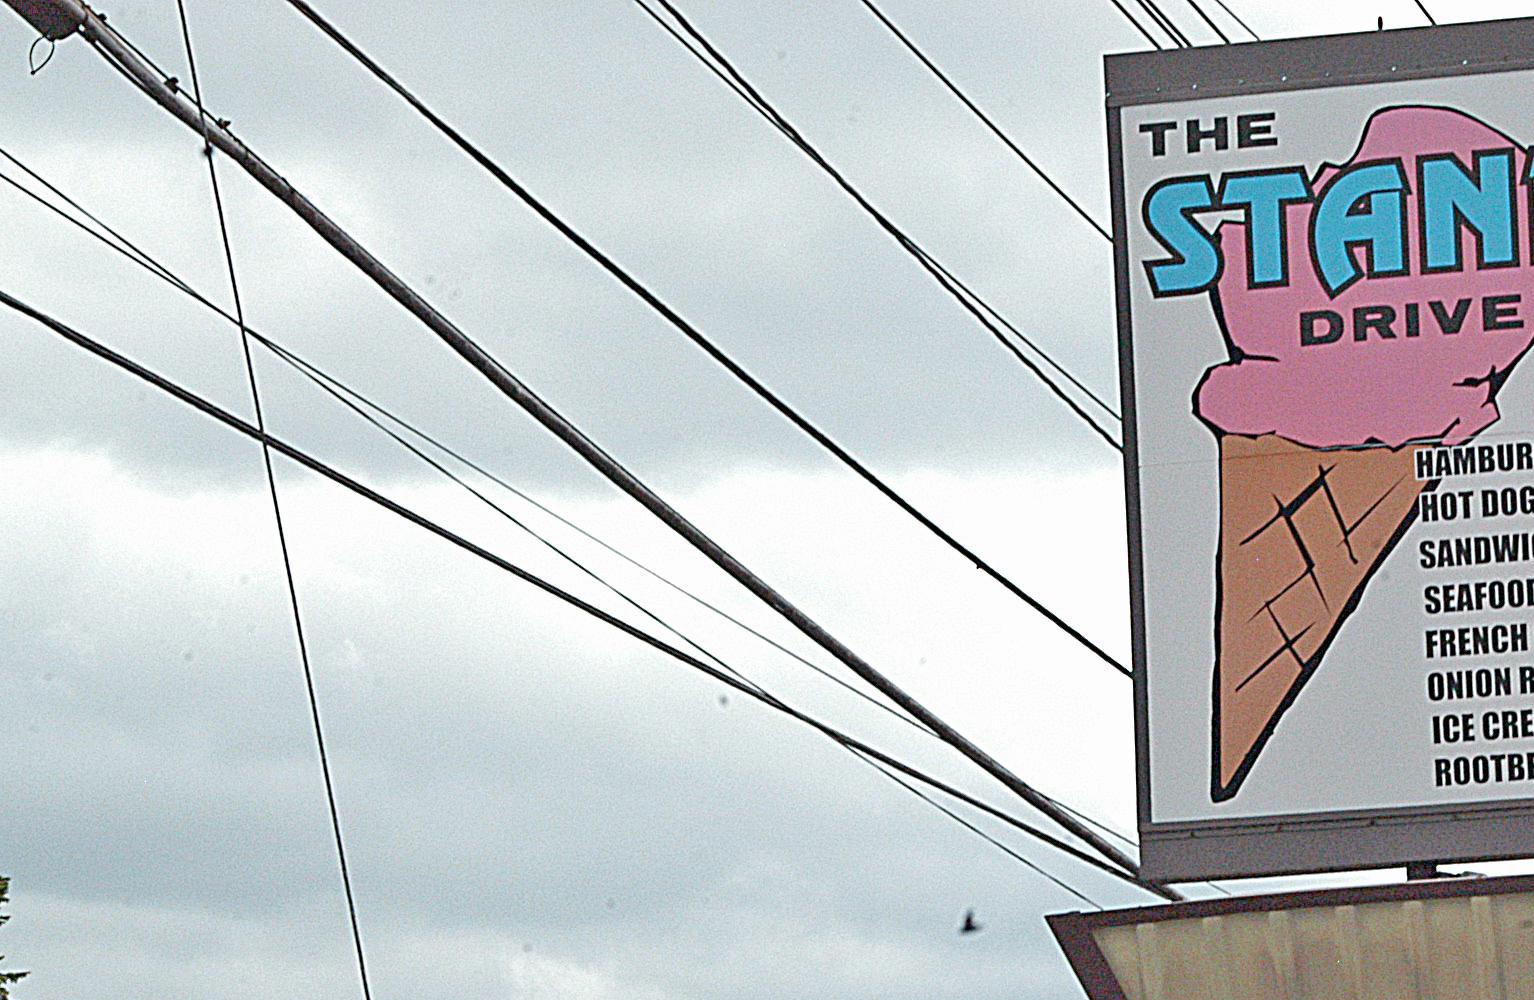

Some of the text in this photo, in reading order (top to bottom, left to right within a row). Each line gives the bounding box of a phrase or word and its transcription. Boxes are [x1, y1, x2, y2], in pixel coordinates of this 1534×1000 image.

[1139, 112, 1278, 156] THE
[1300, 294, 1524, 346] DRIVE
[1421, 491, 1474, 522] HOT
[1425, 623, 1528, 658] FRENCH
[1427, 667, 1511, 701] ONION
[1433, 714, 1475, 744] ICE
